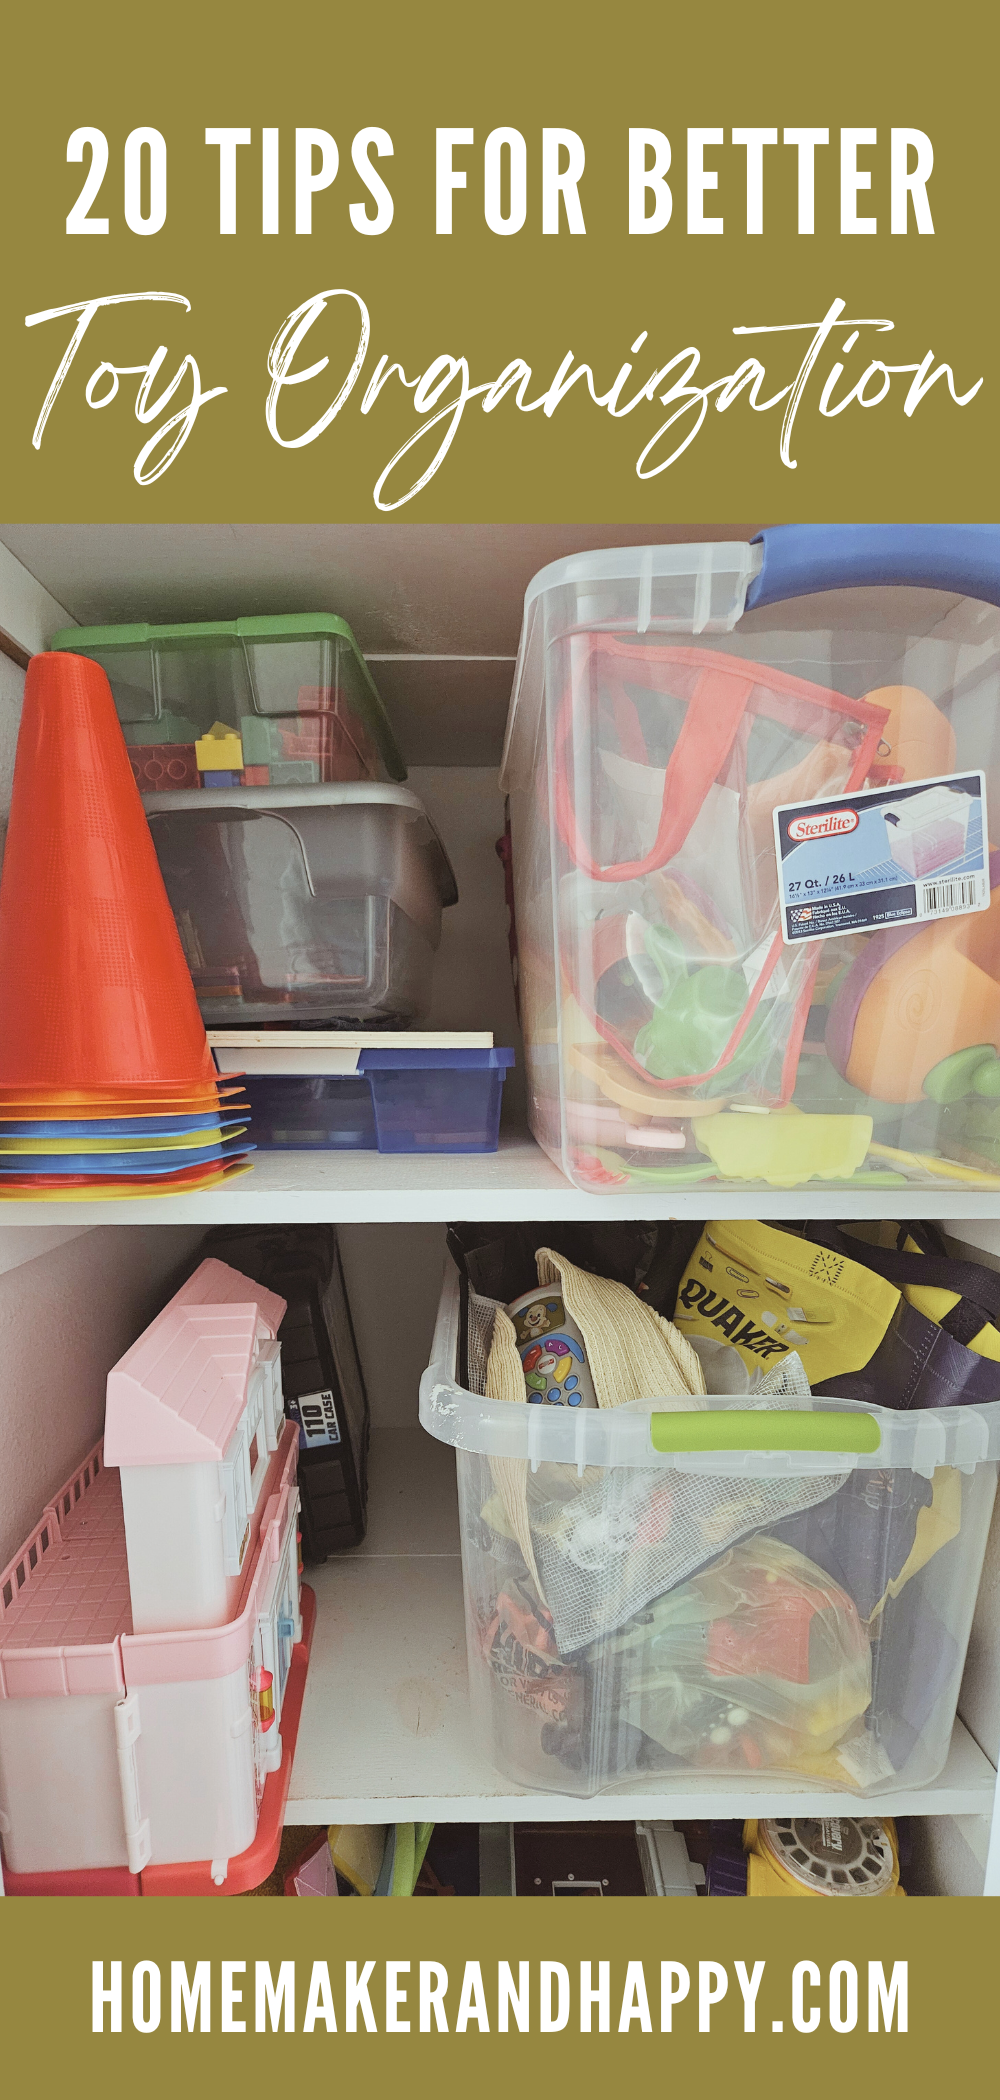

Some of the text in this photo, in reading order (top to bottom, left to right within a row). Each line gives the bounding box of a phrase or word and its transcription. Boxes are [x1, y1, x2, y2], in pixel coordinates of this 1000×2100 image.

[795, 816, 850, 837] Sterilite
[788, 881, 801, 892] 27
[804, 879, 822, 889] Qt.
[832, 873, 846, 884] 26
[848, 872, 855, 882] L
[923, 875, 975, 887] www.sterilite.com
[679, 1278, 789, 1359] QUAKER
[302, 1405, 326, 1438] 110
[321, 1393, 339, 1441] CAR CASE
[830, 1817, 842, 1851] covery
